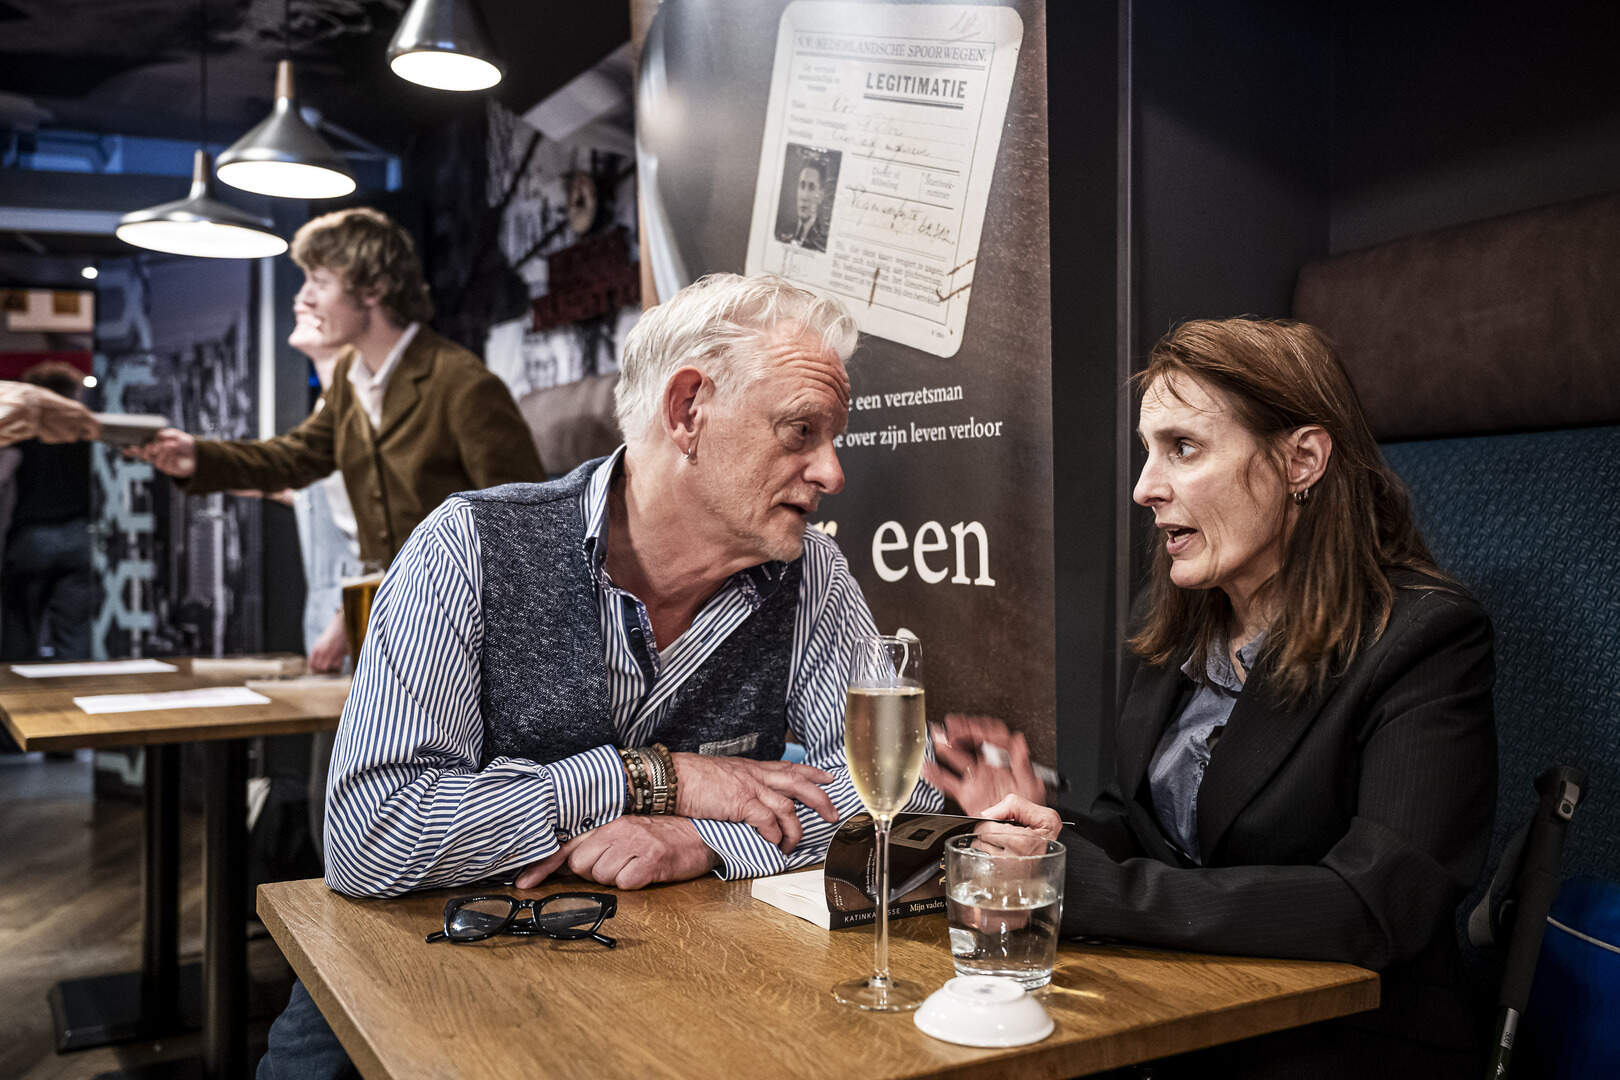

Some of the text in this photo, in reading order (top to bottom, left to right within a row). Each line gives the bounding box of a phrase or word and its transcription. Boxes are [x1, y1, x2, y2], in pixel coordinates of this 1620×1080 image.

[907, 44, 987, 62] SPOORWEGEN.
[866, 71, 968, 99] LEGITIMATIE
[855, 394, 882, 411] een
[884, 385, 964, 408] verzetsman
[846, 431, 877, 448] over
[880, 424, 907, 451] zijn
[910, 421, 947, 443] leven
[949, 416, 1003, 440] verloor
[872, 520, 996, 587] een
[844, 911, 877, 923] KATINKA
[909, 903, 925, 913] Mijn
